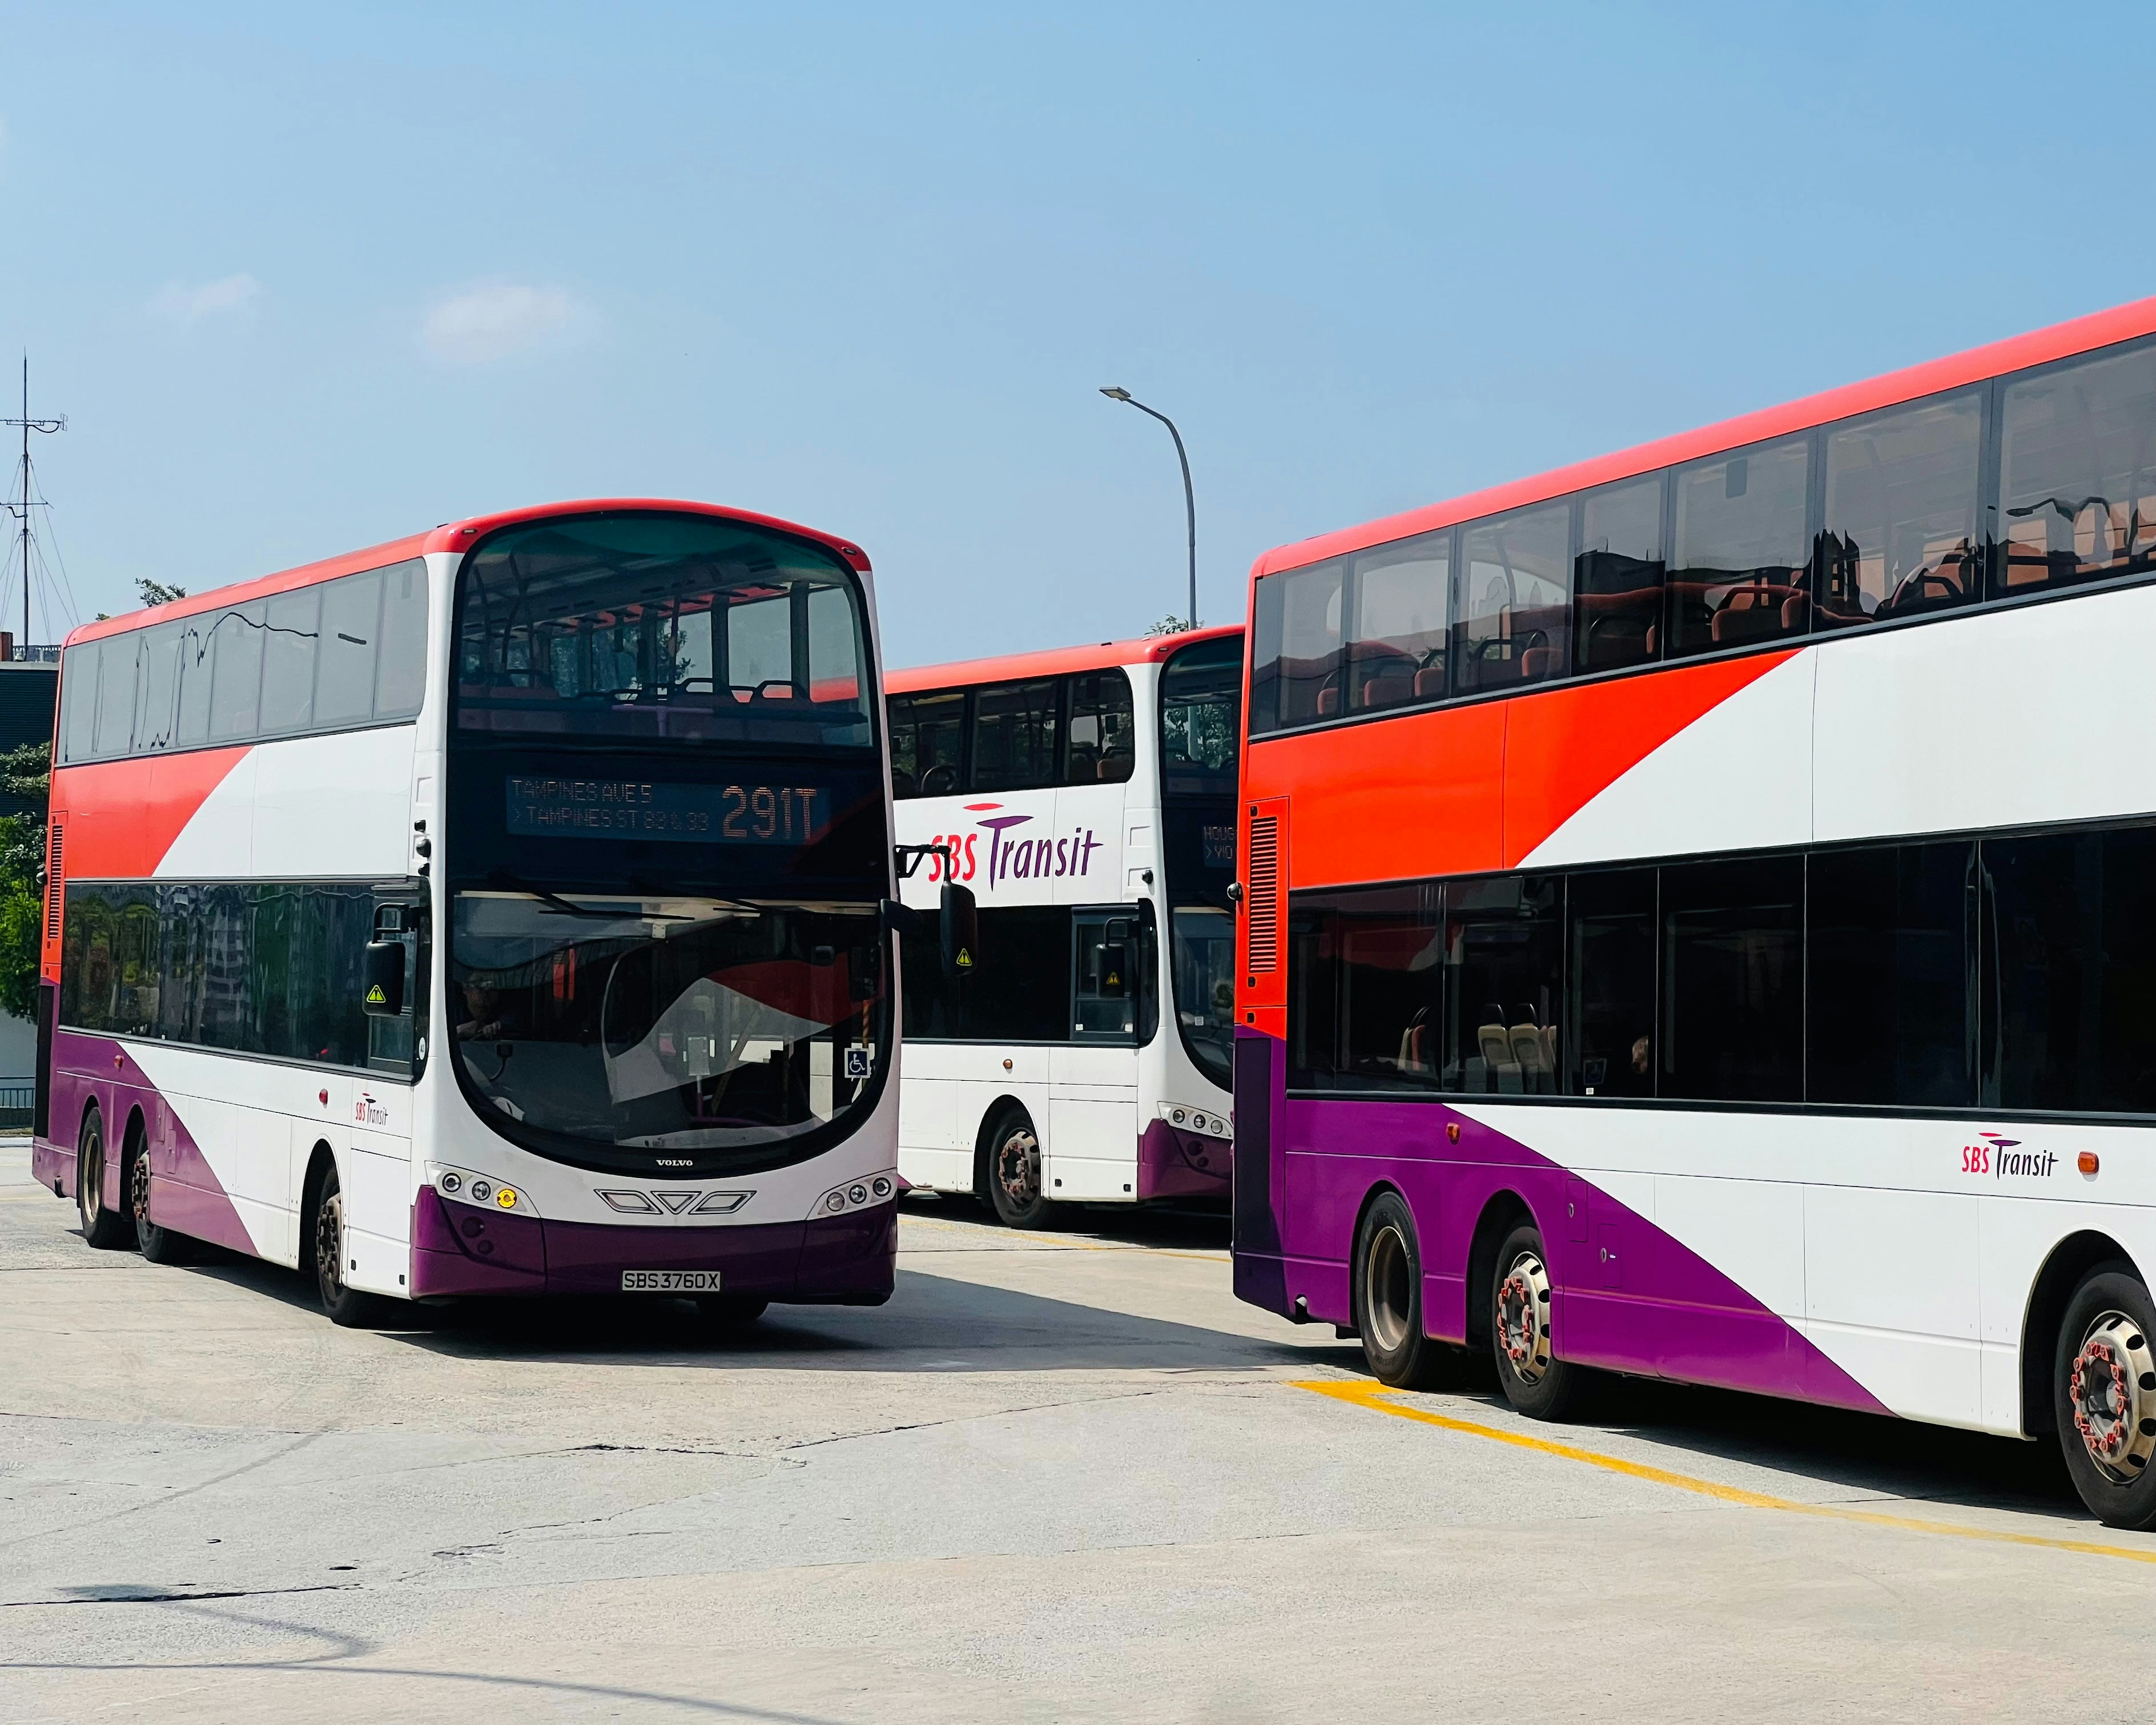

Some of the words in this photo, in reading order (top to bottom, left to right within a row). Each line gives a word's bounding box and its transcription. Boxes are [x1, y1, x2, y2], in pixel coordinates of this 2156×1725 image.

[512, 780, 597, 801] TAMPINES
[602, 783, 637, 802] AVE
[641, 785, 651, 803] 5
[526, 806, 612, 827] TAMPINES
[616, 810, 638, 829] ST
[722, 785, 817, 839] 291T
[928, 833, 978, 882] SBS
[976, 815, 1104, 892] Transit
[356, 1101, 365, 1121] SBS
[365, 1098, 388, 1125] Transit
[1962, 1146, 1989, 1173] SBS
[1988, 1139, 2060, 1180] Transit
[624, 1273, 718, 1289] SBS3760X
